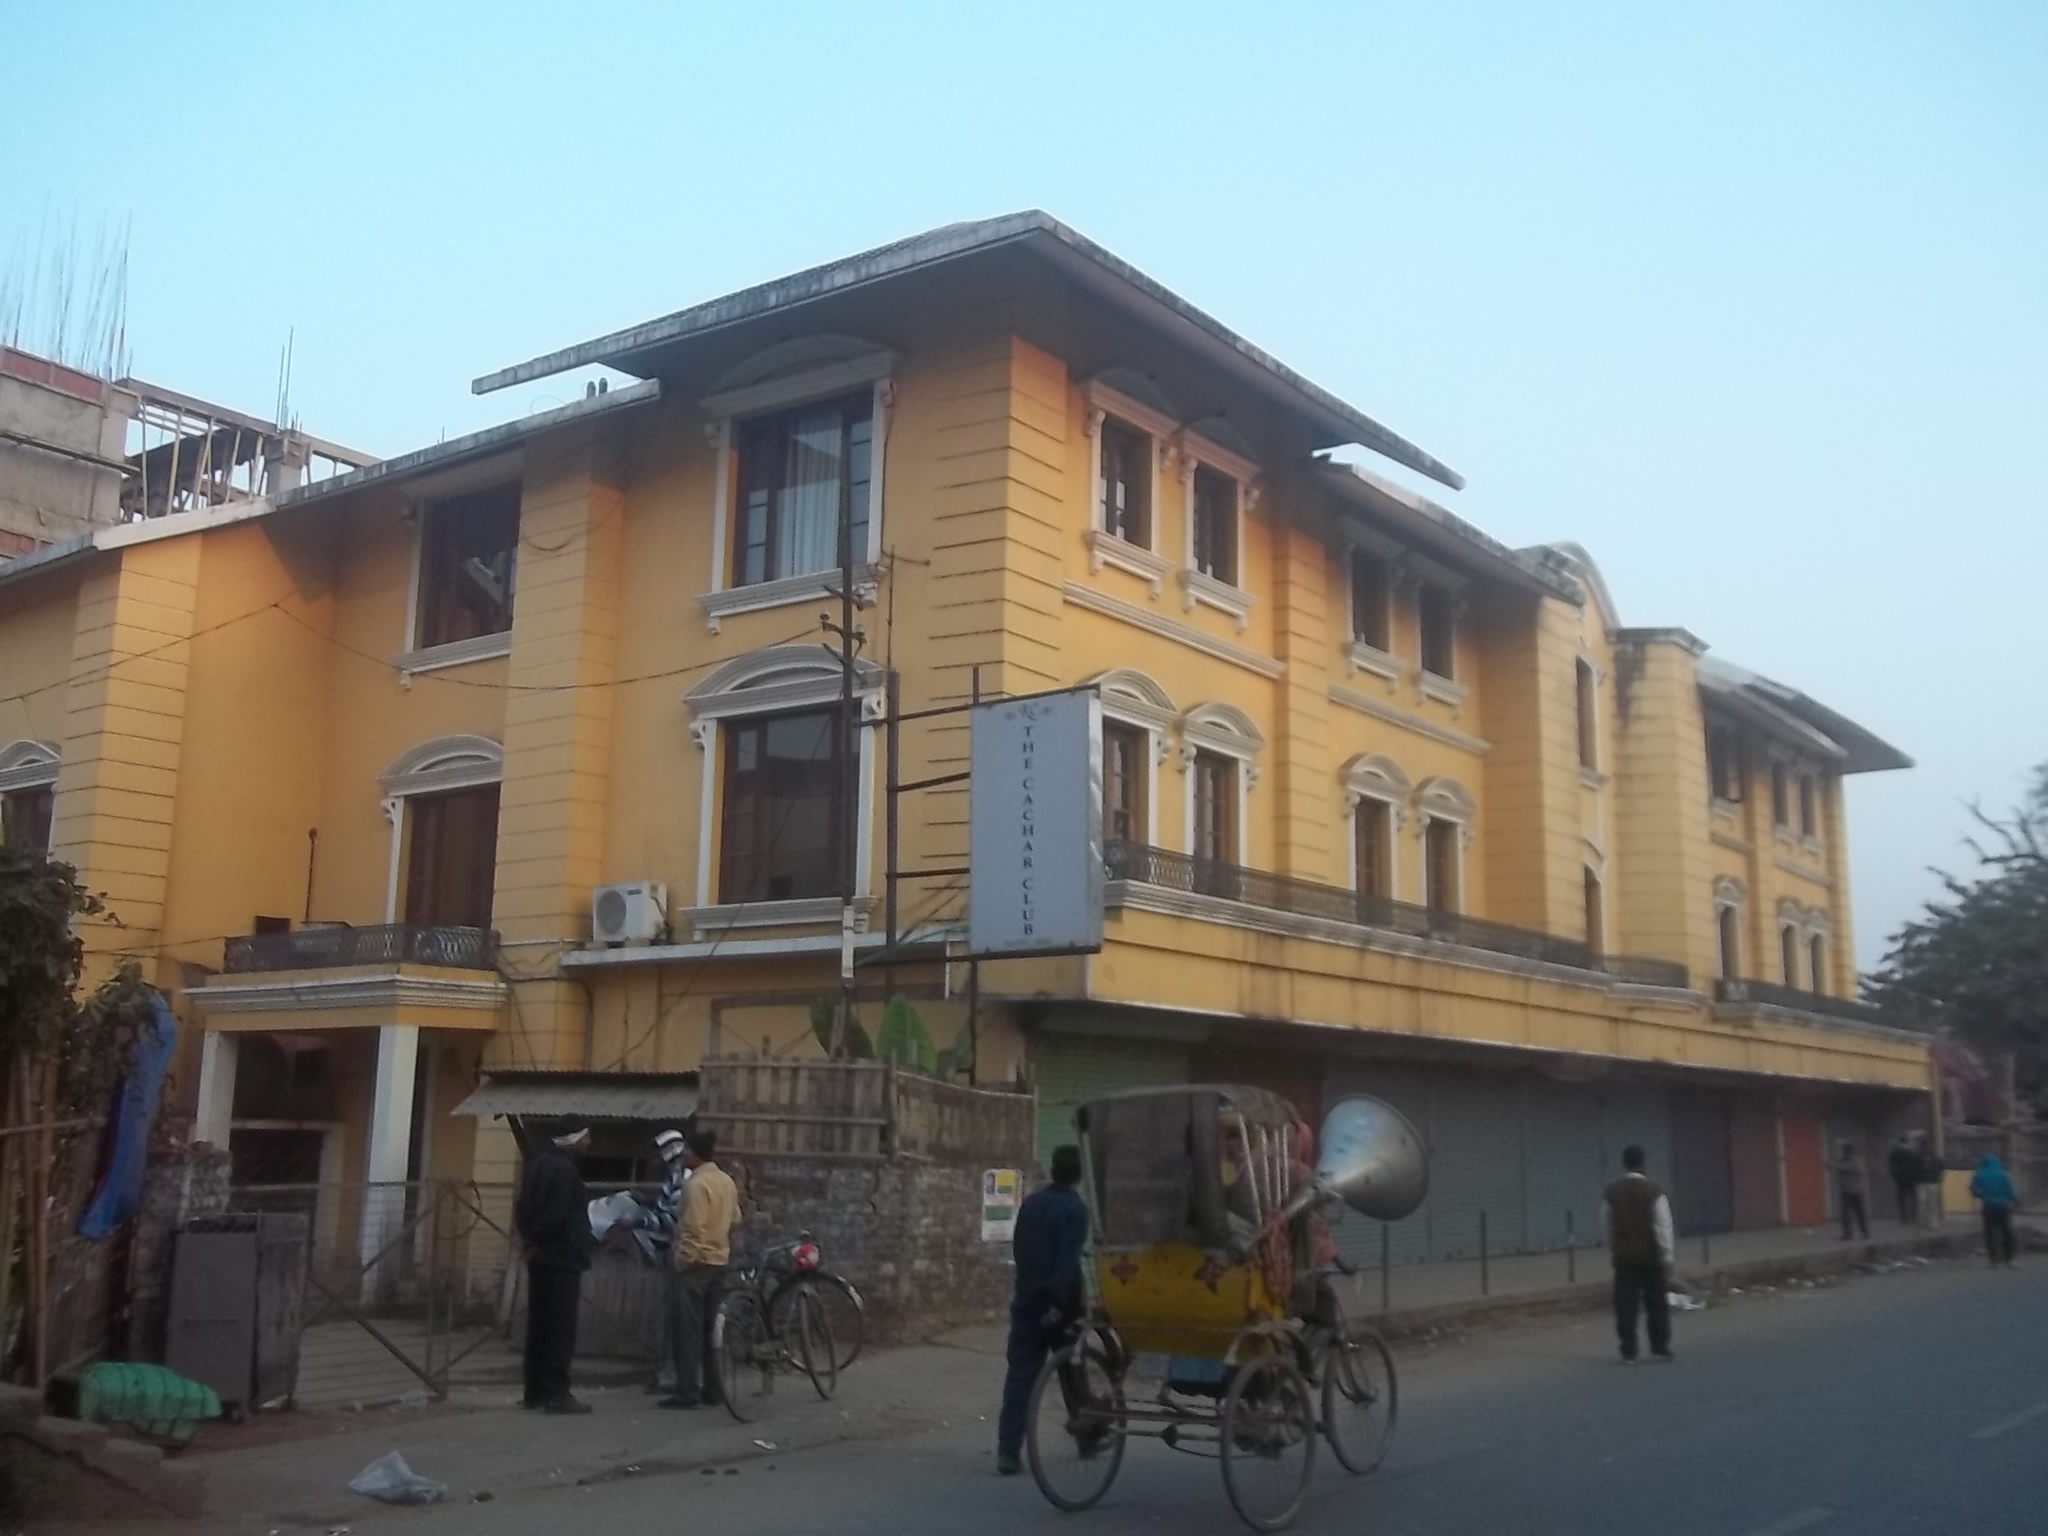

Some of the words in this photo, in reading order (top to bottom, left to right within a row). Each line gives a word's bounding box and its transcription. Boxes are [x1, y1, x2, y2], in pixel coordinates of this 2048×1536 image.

[1021, 725, 1035, 770] THE
[1021, 777, 1035, 869] CACHAR
[1021, 877, 1035, 935] CLUB
